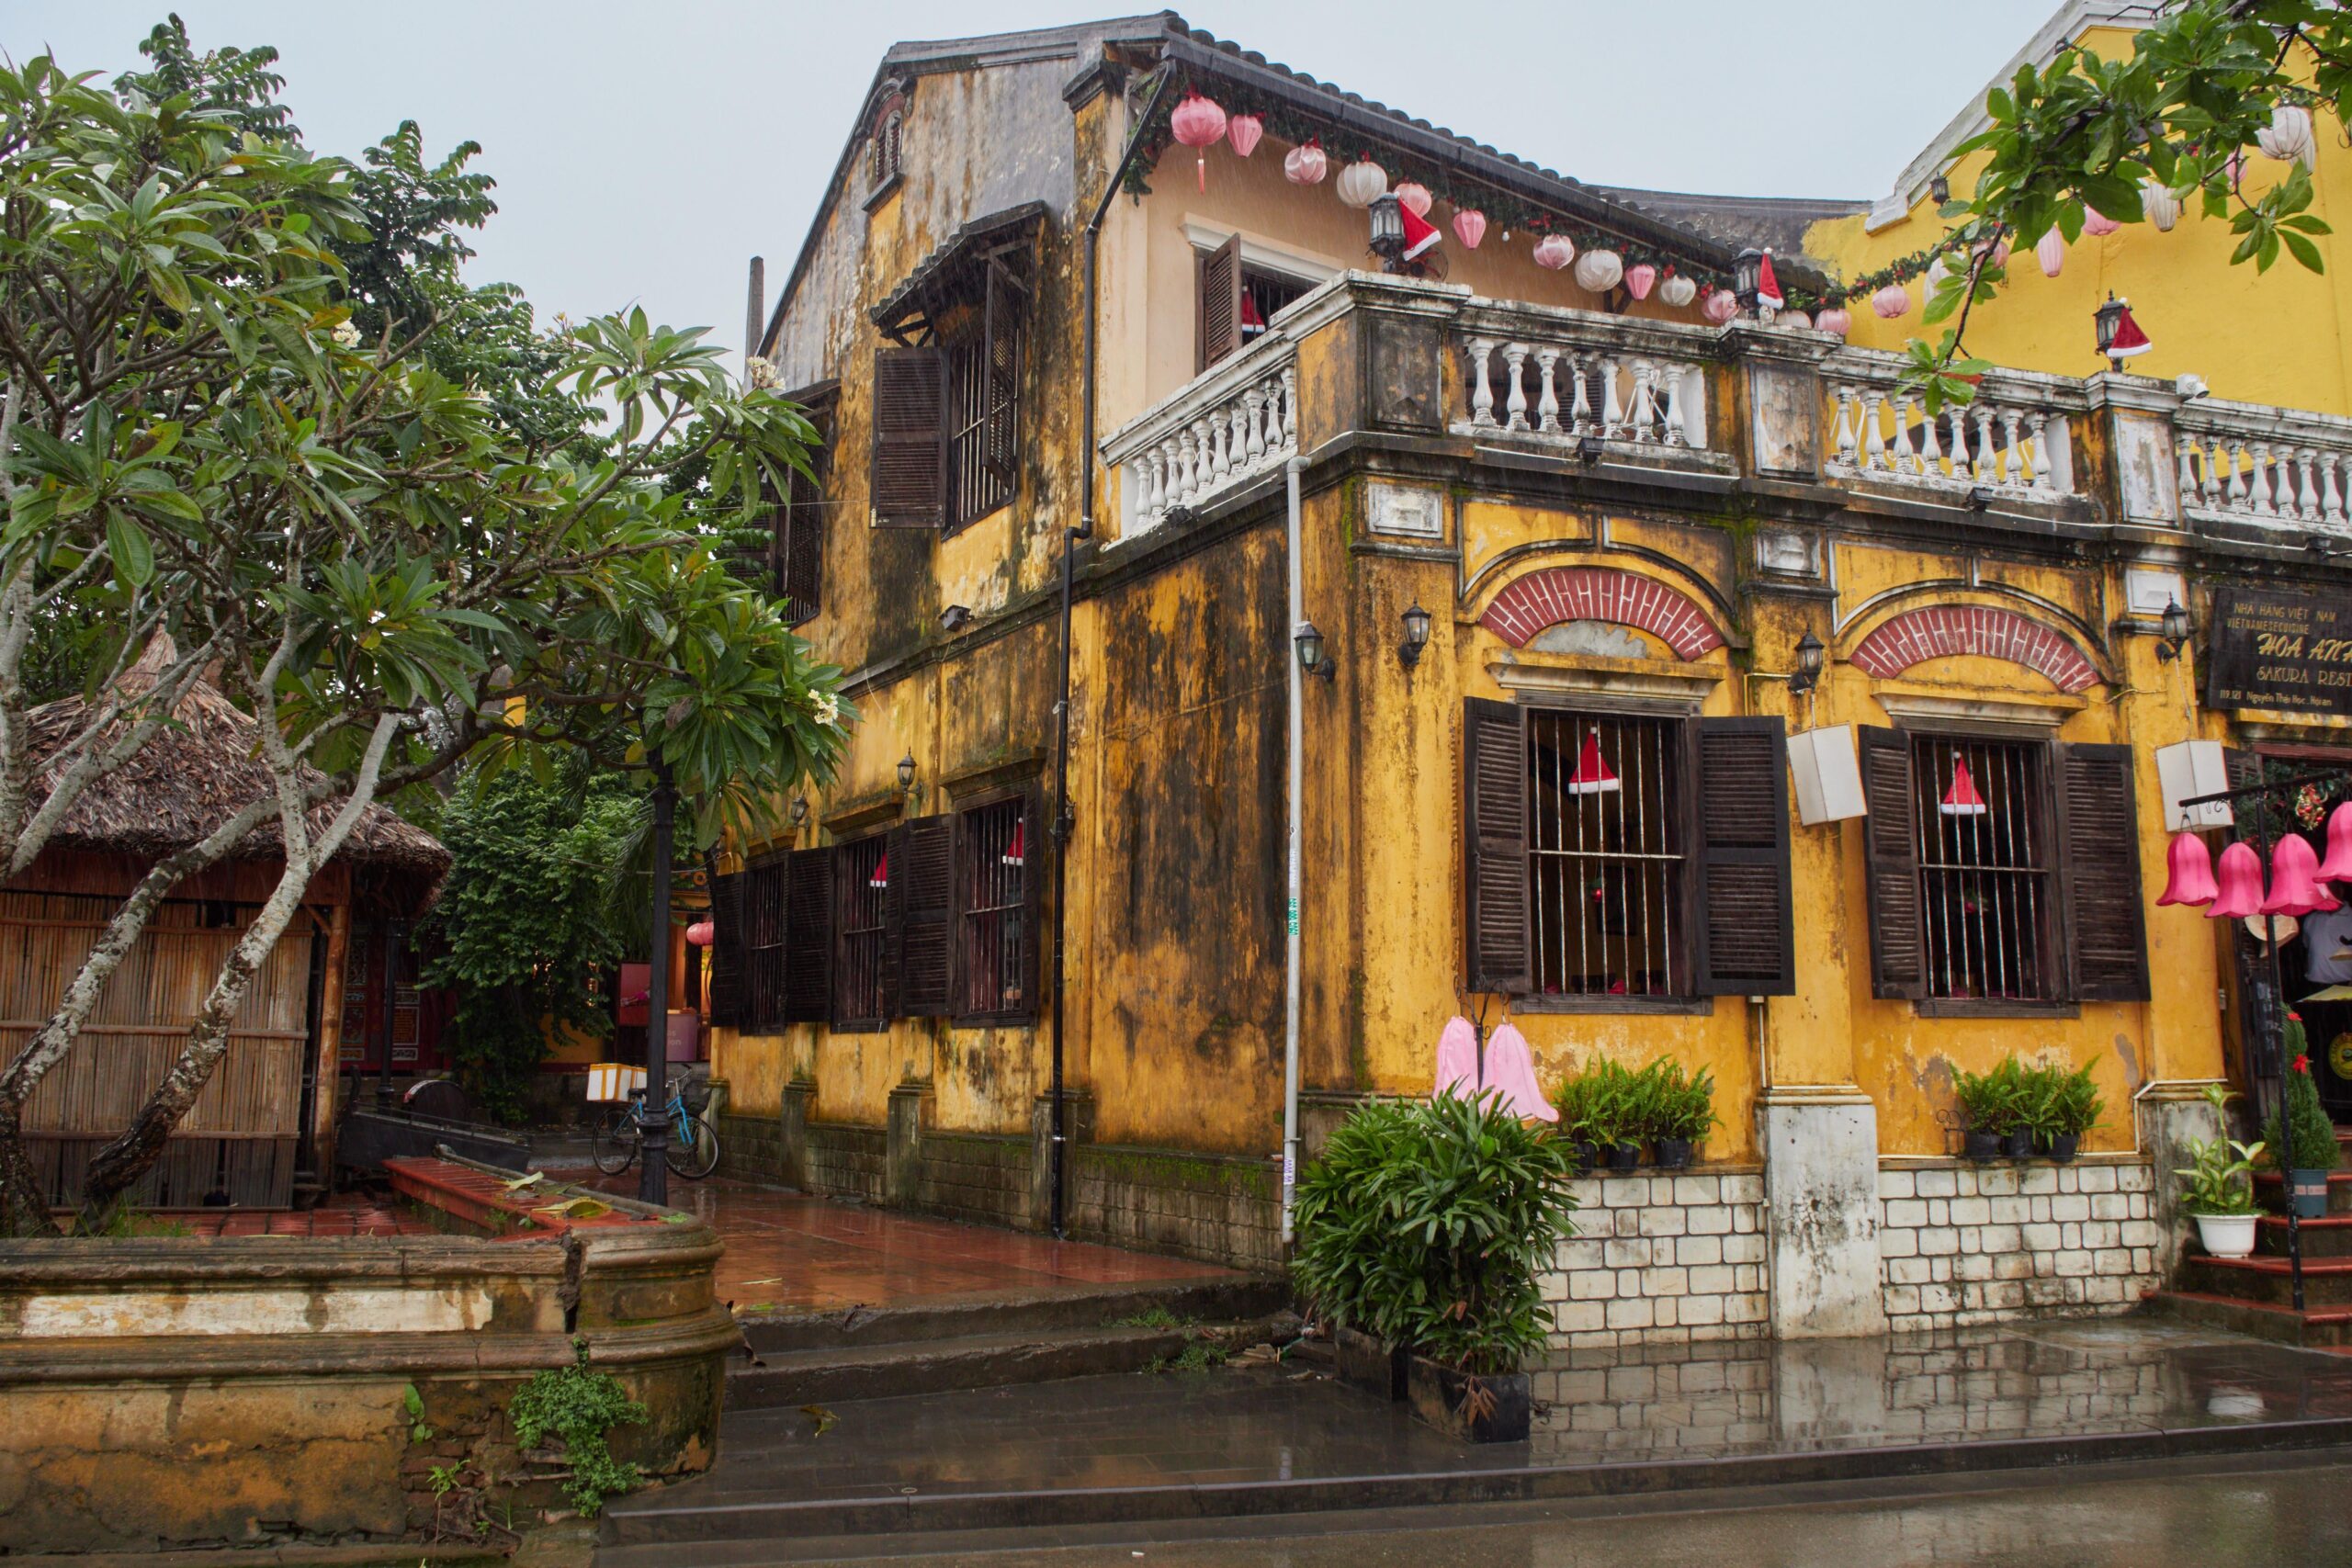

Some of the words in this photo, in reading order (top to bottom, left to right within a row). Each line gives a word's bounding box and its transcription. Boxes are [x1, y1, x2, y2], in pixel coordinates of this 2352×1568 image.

[2315, 610, 2336, 623] NAM
[2256, 633, 2304, 659] HOA
[2256, 666, 2310, 684] SAKURA
